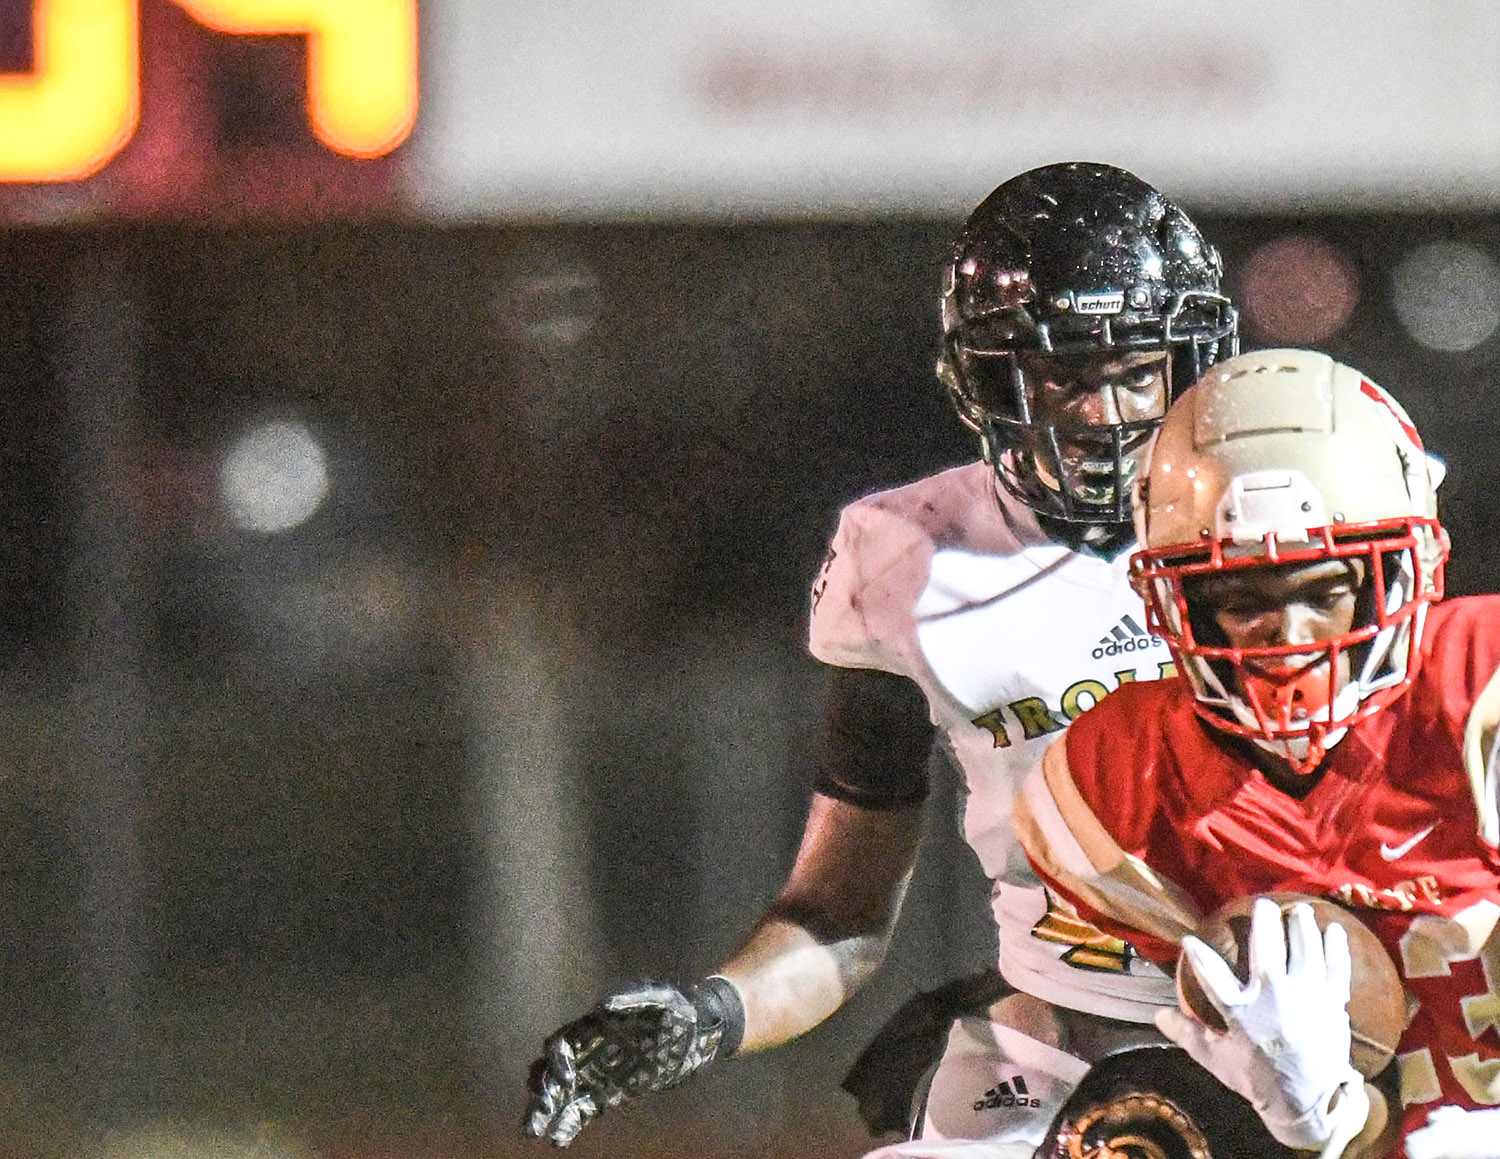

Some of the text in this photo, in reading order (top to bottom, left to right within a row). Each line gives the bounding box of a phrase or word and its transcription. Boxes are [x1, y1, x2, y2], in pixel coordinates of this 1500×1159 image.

[1081, 300, 1121, 311] schutt
[1092, 632, 1163, 660] adidas
[973, 1093, 1041, 1111] adidas
